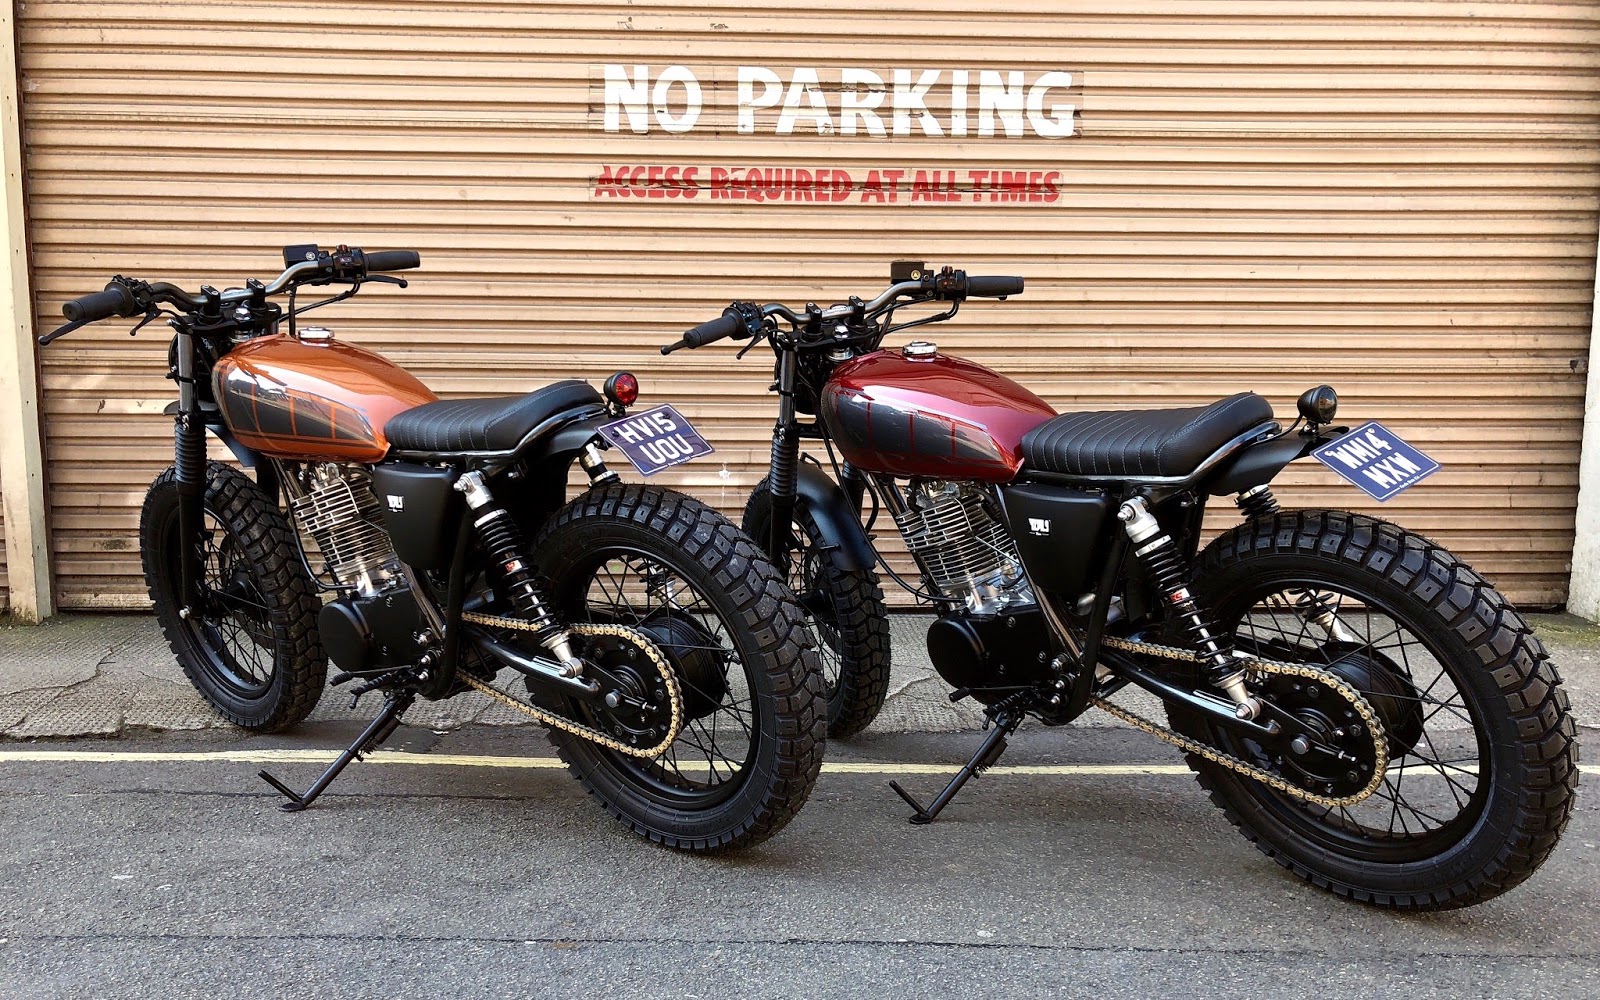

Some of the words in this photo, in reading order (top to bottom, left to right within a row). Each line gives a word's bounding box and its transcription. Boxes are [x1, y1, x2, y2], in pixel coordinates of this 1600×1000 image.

[604, 64, 702, 134] NO
[737, 66, 1076, 139] PARKING
[594, 164, 699, 199] ACCESS
[710, 166, 852, 203] REQUIRED
[860, 170, 905, 203] AT
[911, 170, 962, 202] ALL
[968, 170, 1060, 203] TIMES
[613, 411, 677, 444] HV15
[638, 433, 694, 465] UOU
[1331, 431, 1393, 470] WM14
[1361, 451, 1422, 490] MXW
